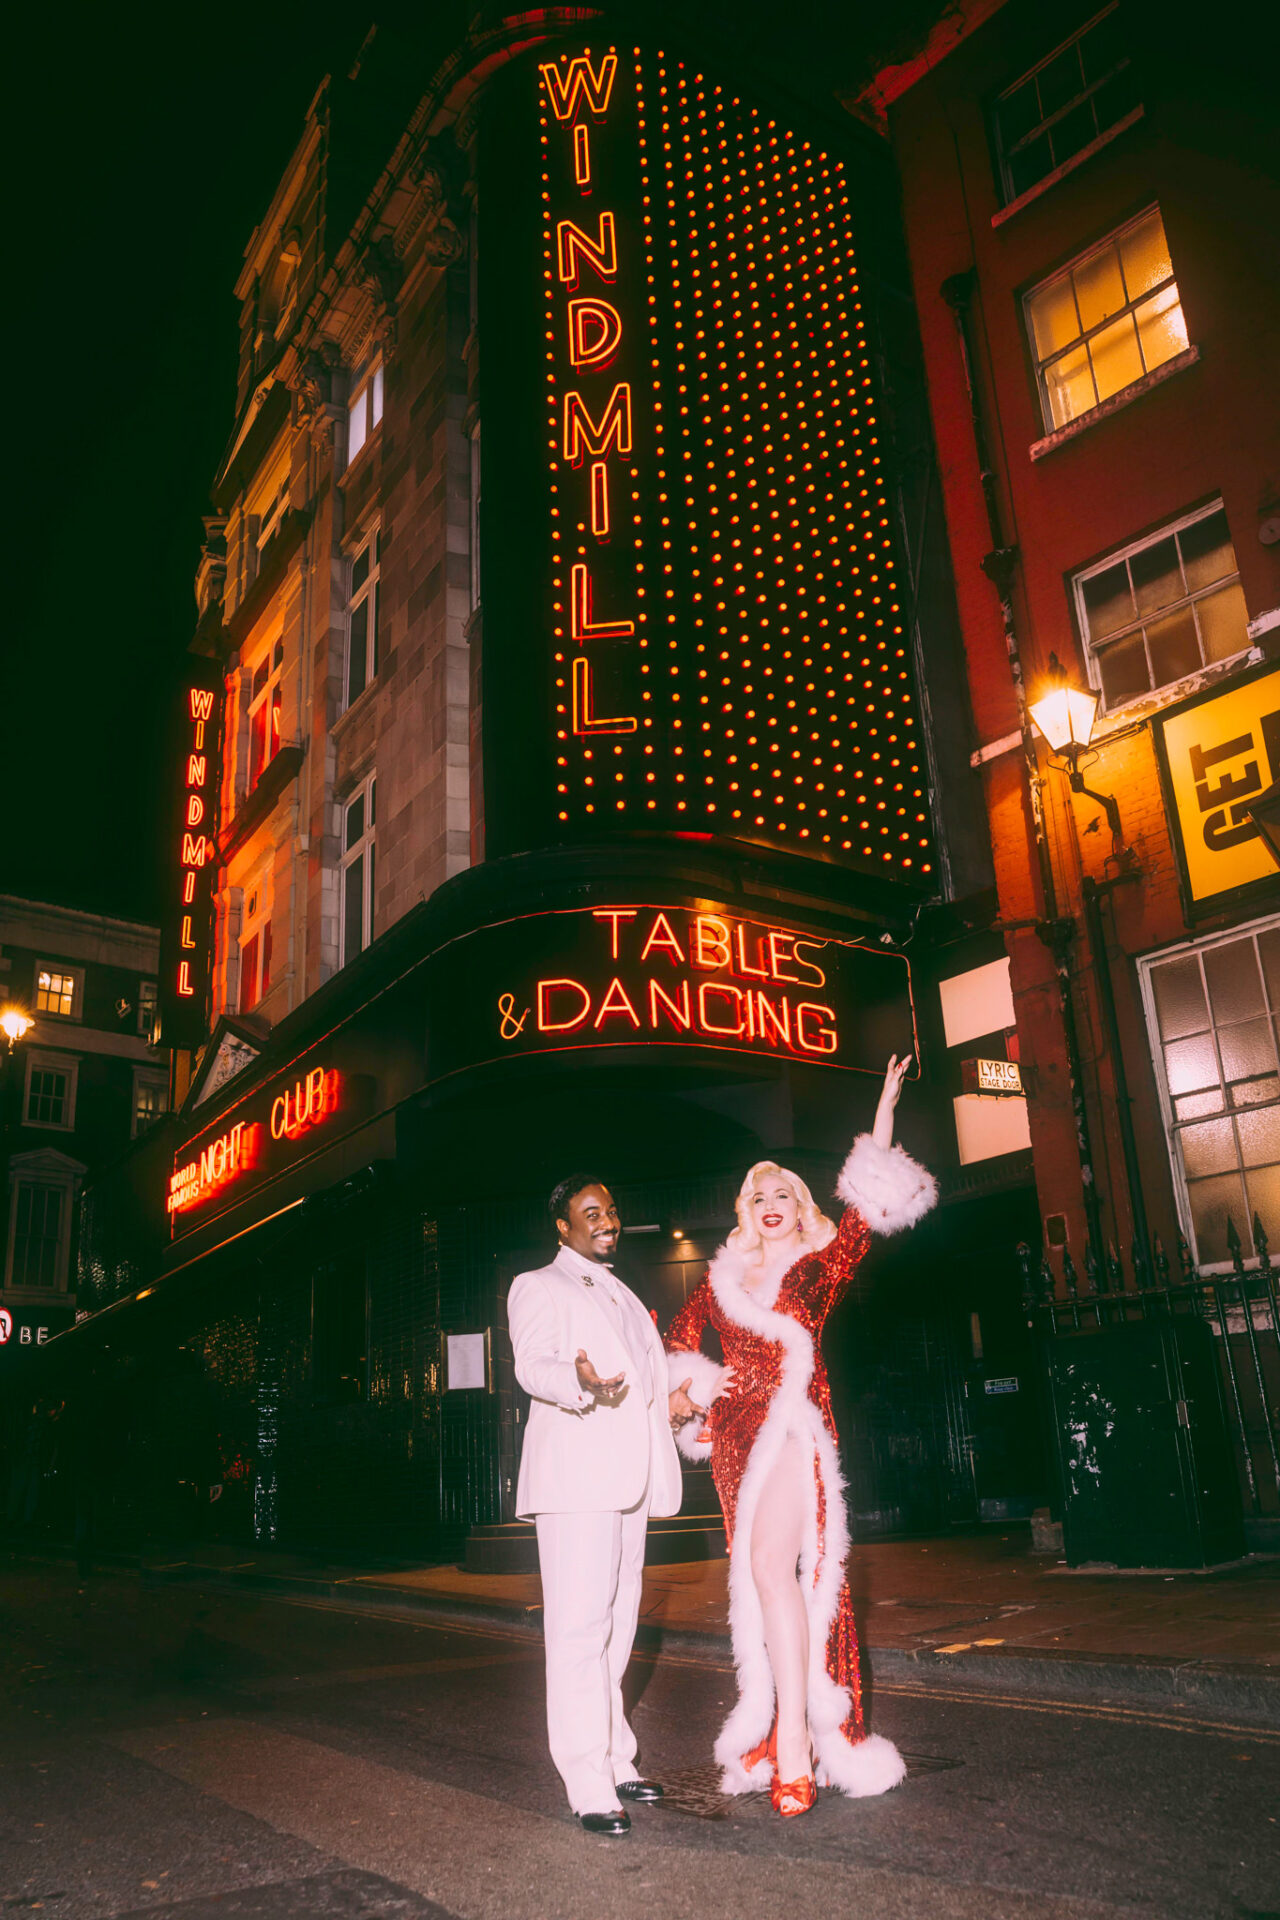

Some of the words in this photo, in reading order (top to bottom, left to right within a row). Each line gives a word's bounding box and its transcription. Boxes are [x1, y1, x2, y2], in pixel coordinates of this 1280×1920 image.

[541, 54, 638, 736] WINDMILL
[1188, 732, 1263, 852] GET
[179, 688, 214, 995] WINDMILL
[592, 910, 826, 988] TABLES
[498, 993, 532, 1040] &
[537, 977, 838, 1054] DANCING
[980, 1061, 1016, 1079] LYRIC
[980, 1078, 1001, 1088] STAGE
[1003, 1079, 1020, 1089] DOOR
[200, 1121, 246, 1189] NIGHT
[270, 1066, 325, 1140] CLUB
[168, 1180, 200, 1213] FAMOUS
[171, 1162, 197, 1193] WORLD
